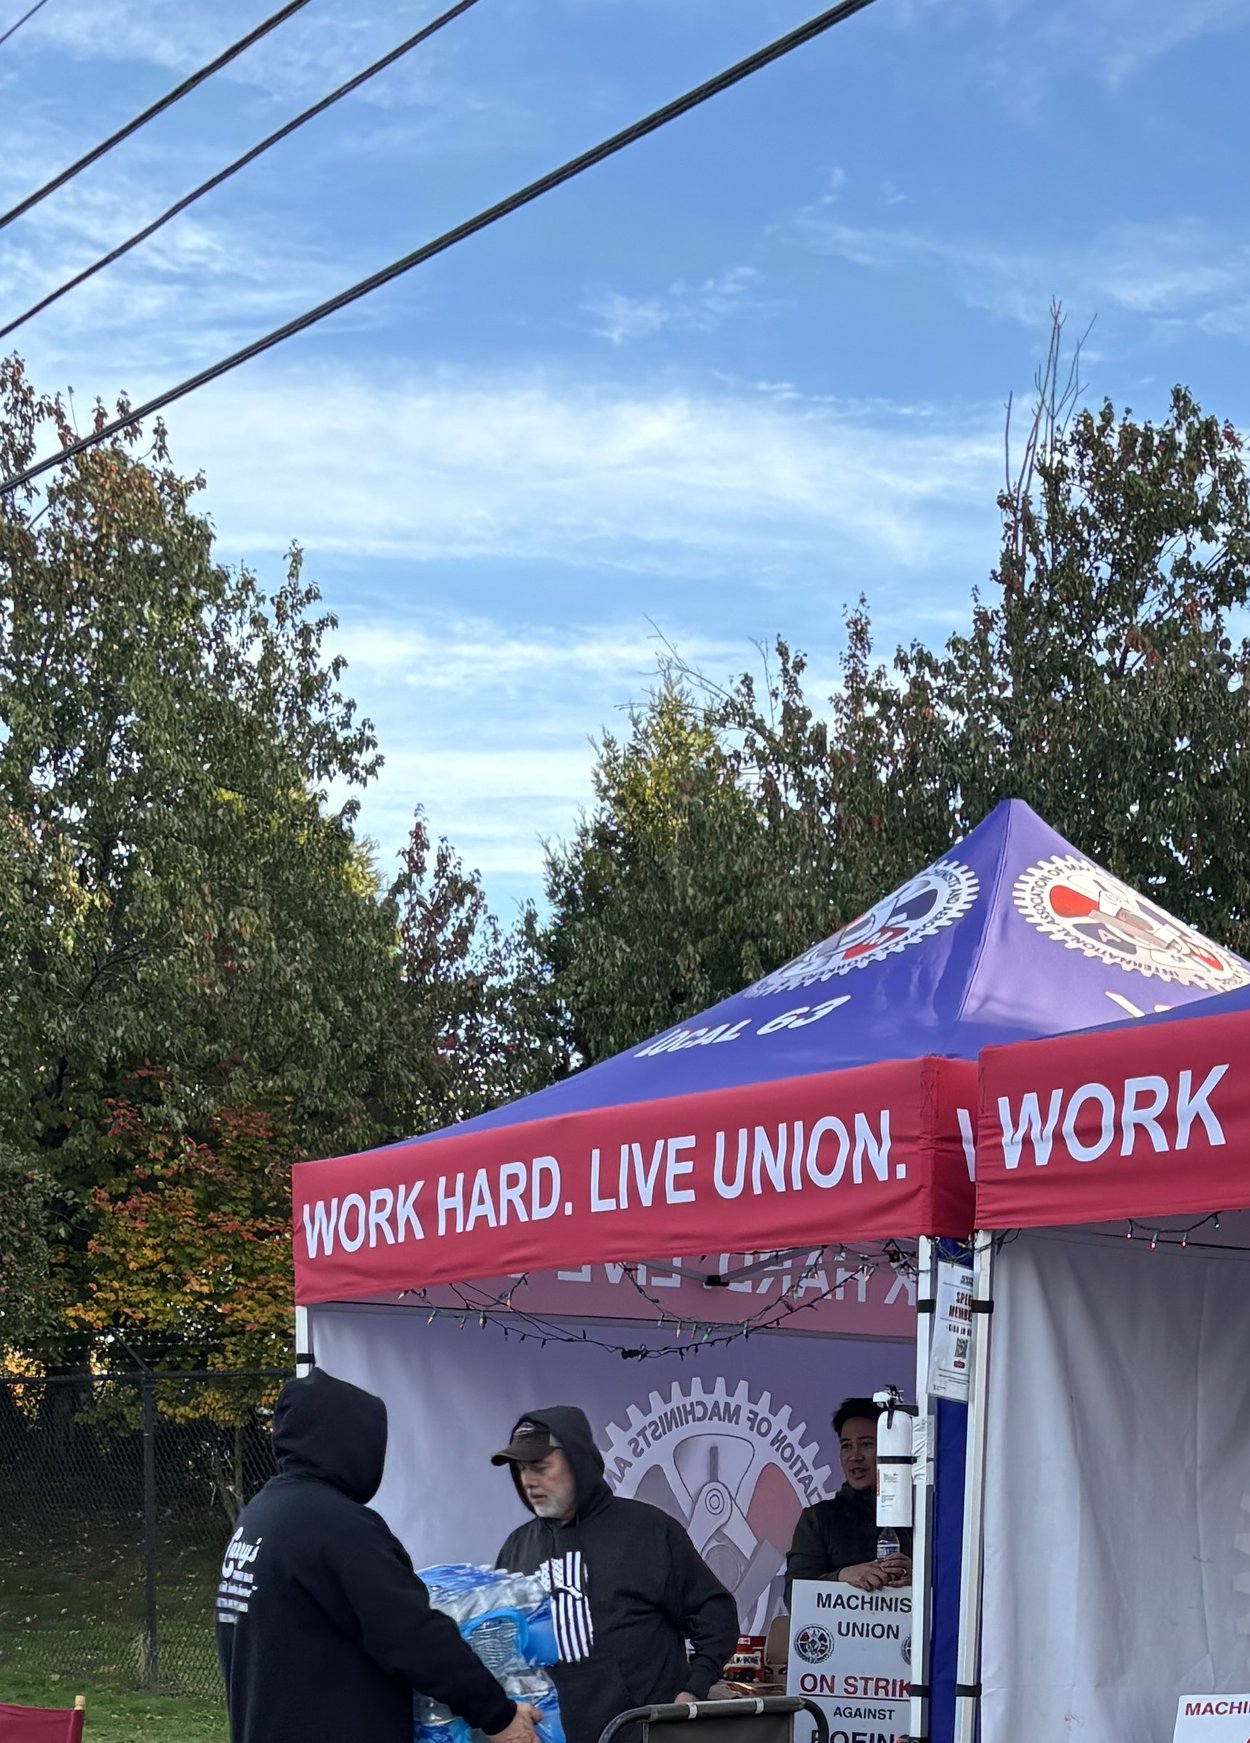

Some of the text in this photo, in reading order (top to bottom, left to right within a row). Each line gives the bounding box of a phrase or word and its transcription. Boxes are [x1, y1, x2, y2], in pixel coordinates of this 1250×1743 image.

[633, 995, 851, 1058] LOCAL 63
[997, 1063, 1230, 1170] WORK
[303, 1181, 425, 1259] WORK
[437, 1156, 573, 1236] HARD.
[591, 1136, 696, 1213] LIVE
[714, 1110, 907, 1198] UNION.
[817, 1592, 912, 1613] MACHINIS
[837, 1621, 899, 1639] UNION
[800, 1673, 911, 1698] ON STRIK
[833, 1707, 895, 1721] AGAINST
